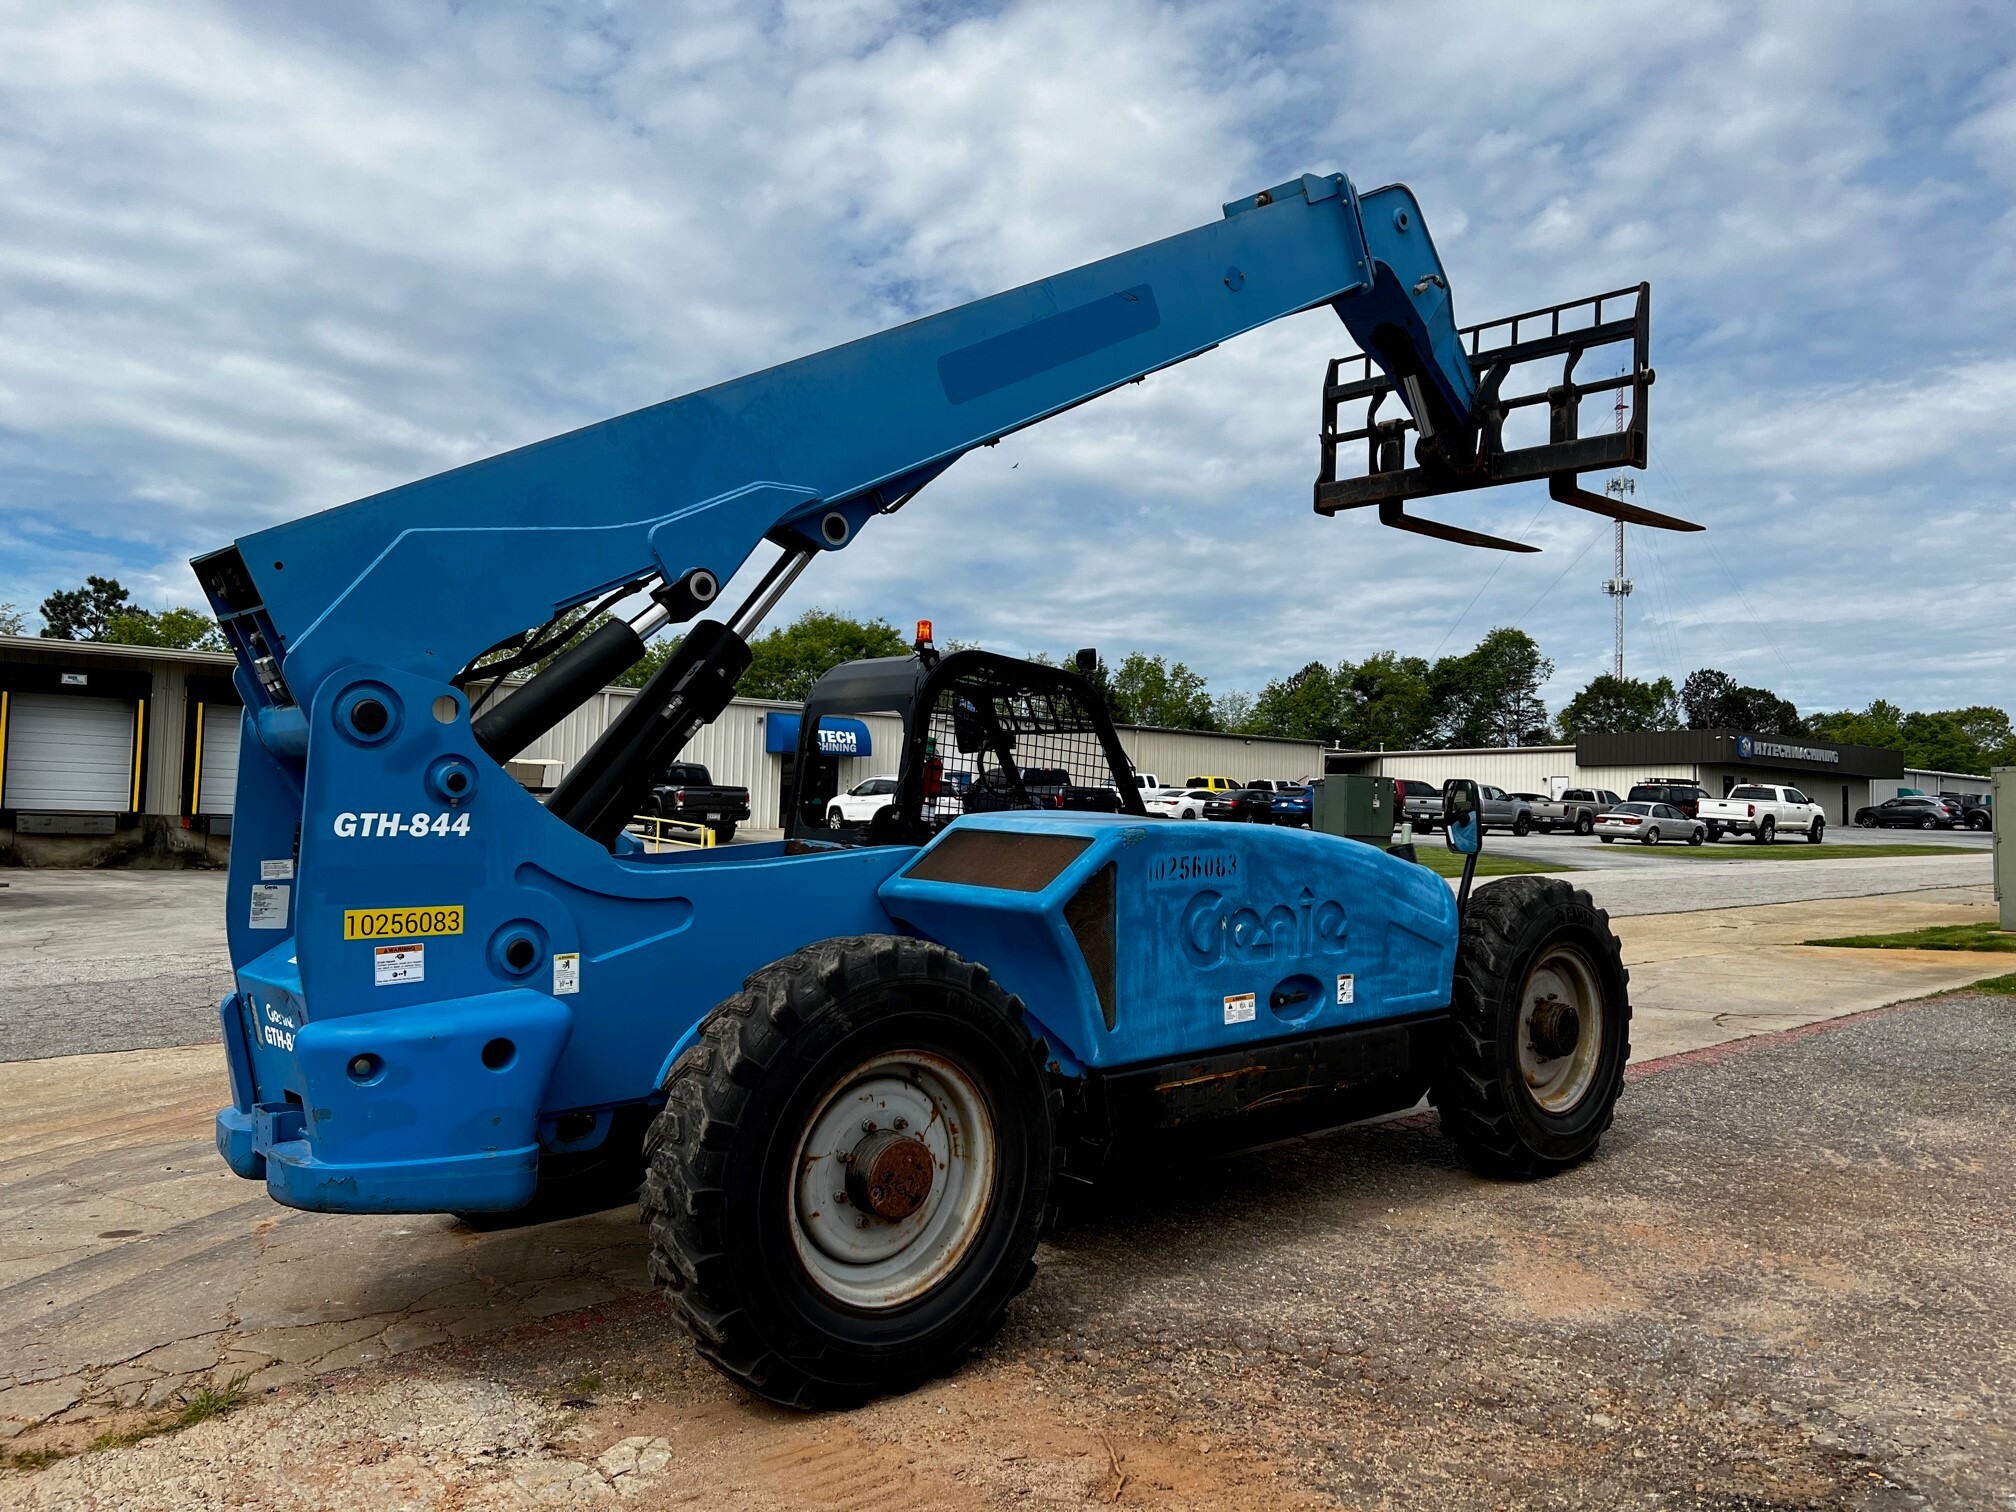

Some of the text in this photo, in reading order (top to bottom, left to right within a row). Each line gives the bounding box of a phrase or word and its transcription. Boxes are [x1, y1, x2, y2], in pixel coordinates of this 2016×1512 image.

[333, 812, 471, 837] GTH-844
[346, 911, 460, 937] 10256083
[1181, 886, 1348, 971] Genie
[264, 1025, 296, 1052] GTH-8
